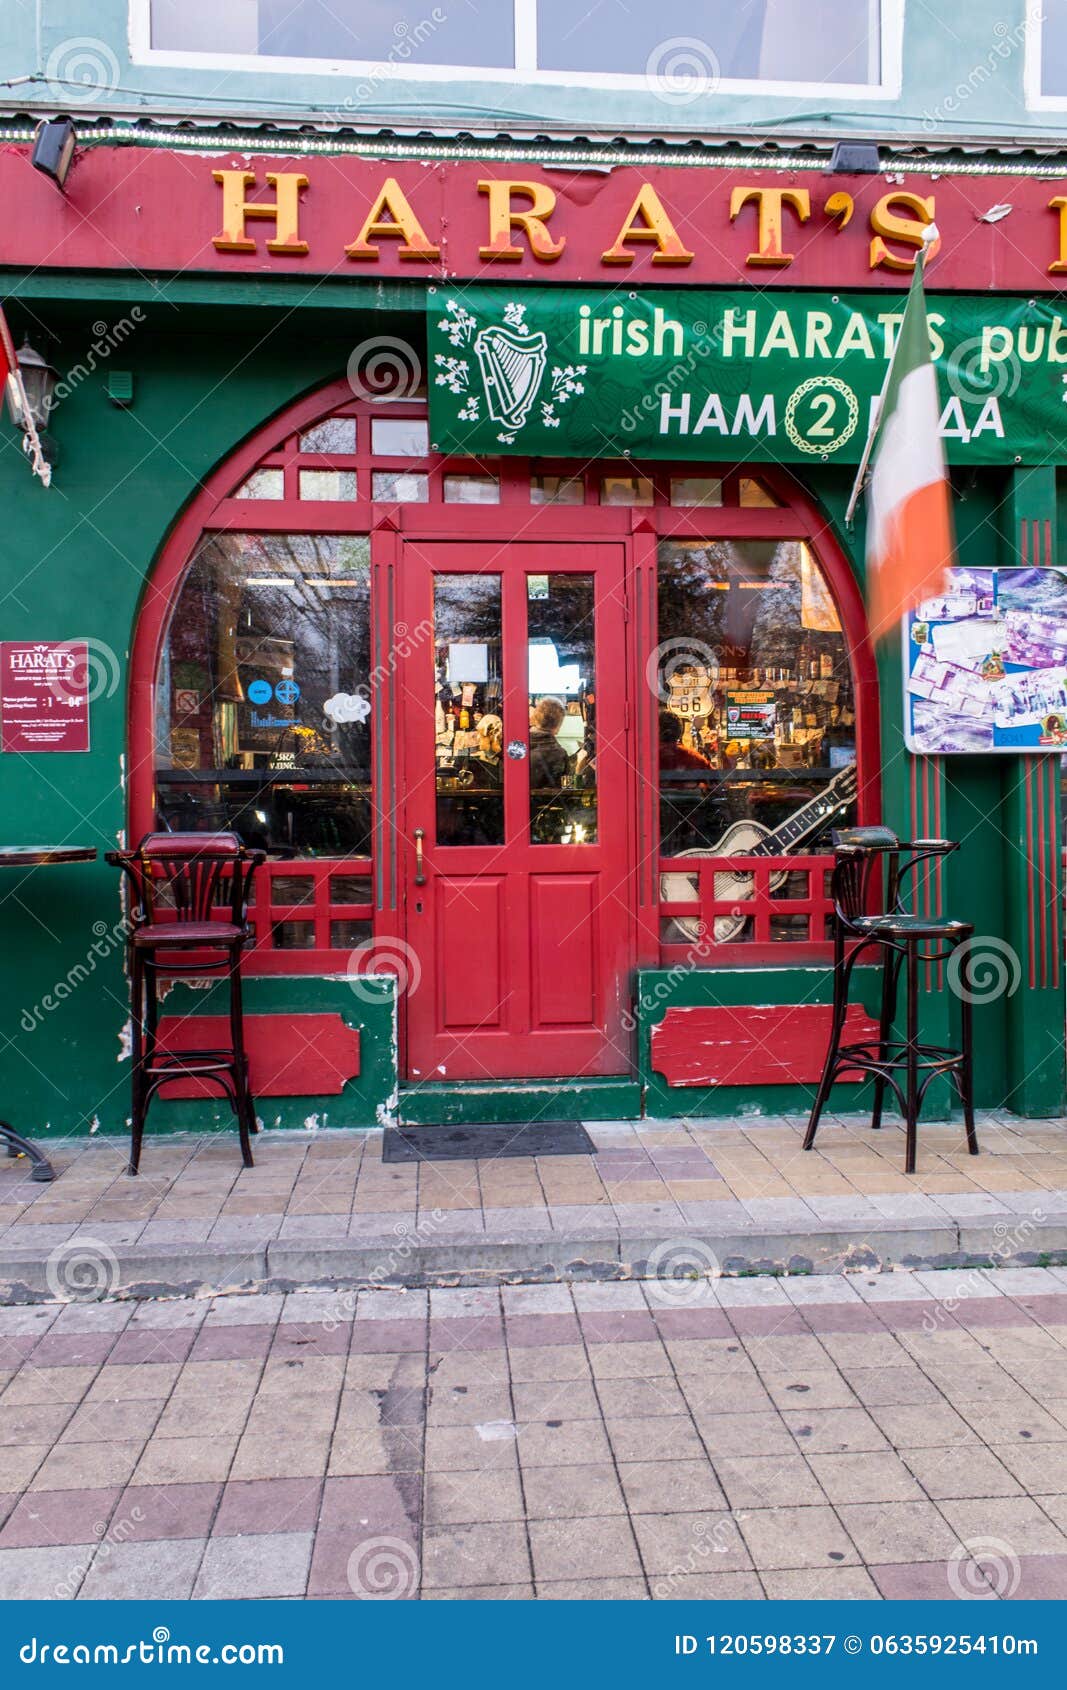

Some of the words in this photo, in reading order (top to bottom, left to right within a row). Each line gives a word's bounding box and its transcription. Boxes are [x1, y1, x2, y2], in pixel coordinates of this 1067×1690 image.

[211, 169, 941, 270] HARAT'S
[579, 305, 684, 356] irish
[722, 310, 946, 361] HARATS
[980, 316, 1067, 372] pub
[659, 393, 777, 435] НАМ
[807, 394, 835, 436] 2
[9, 653, 76, 668] HARAT'S
[680, 697, 700, 712] 66
